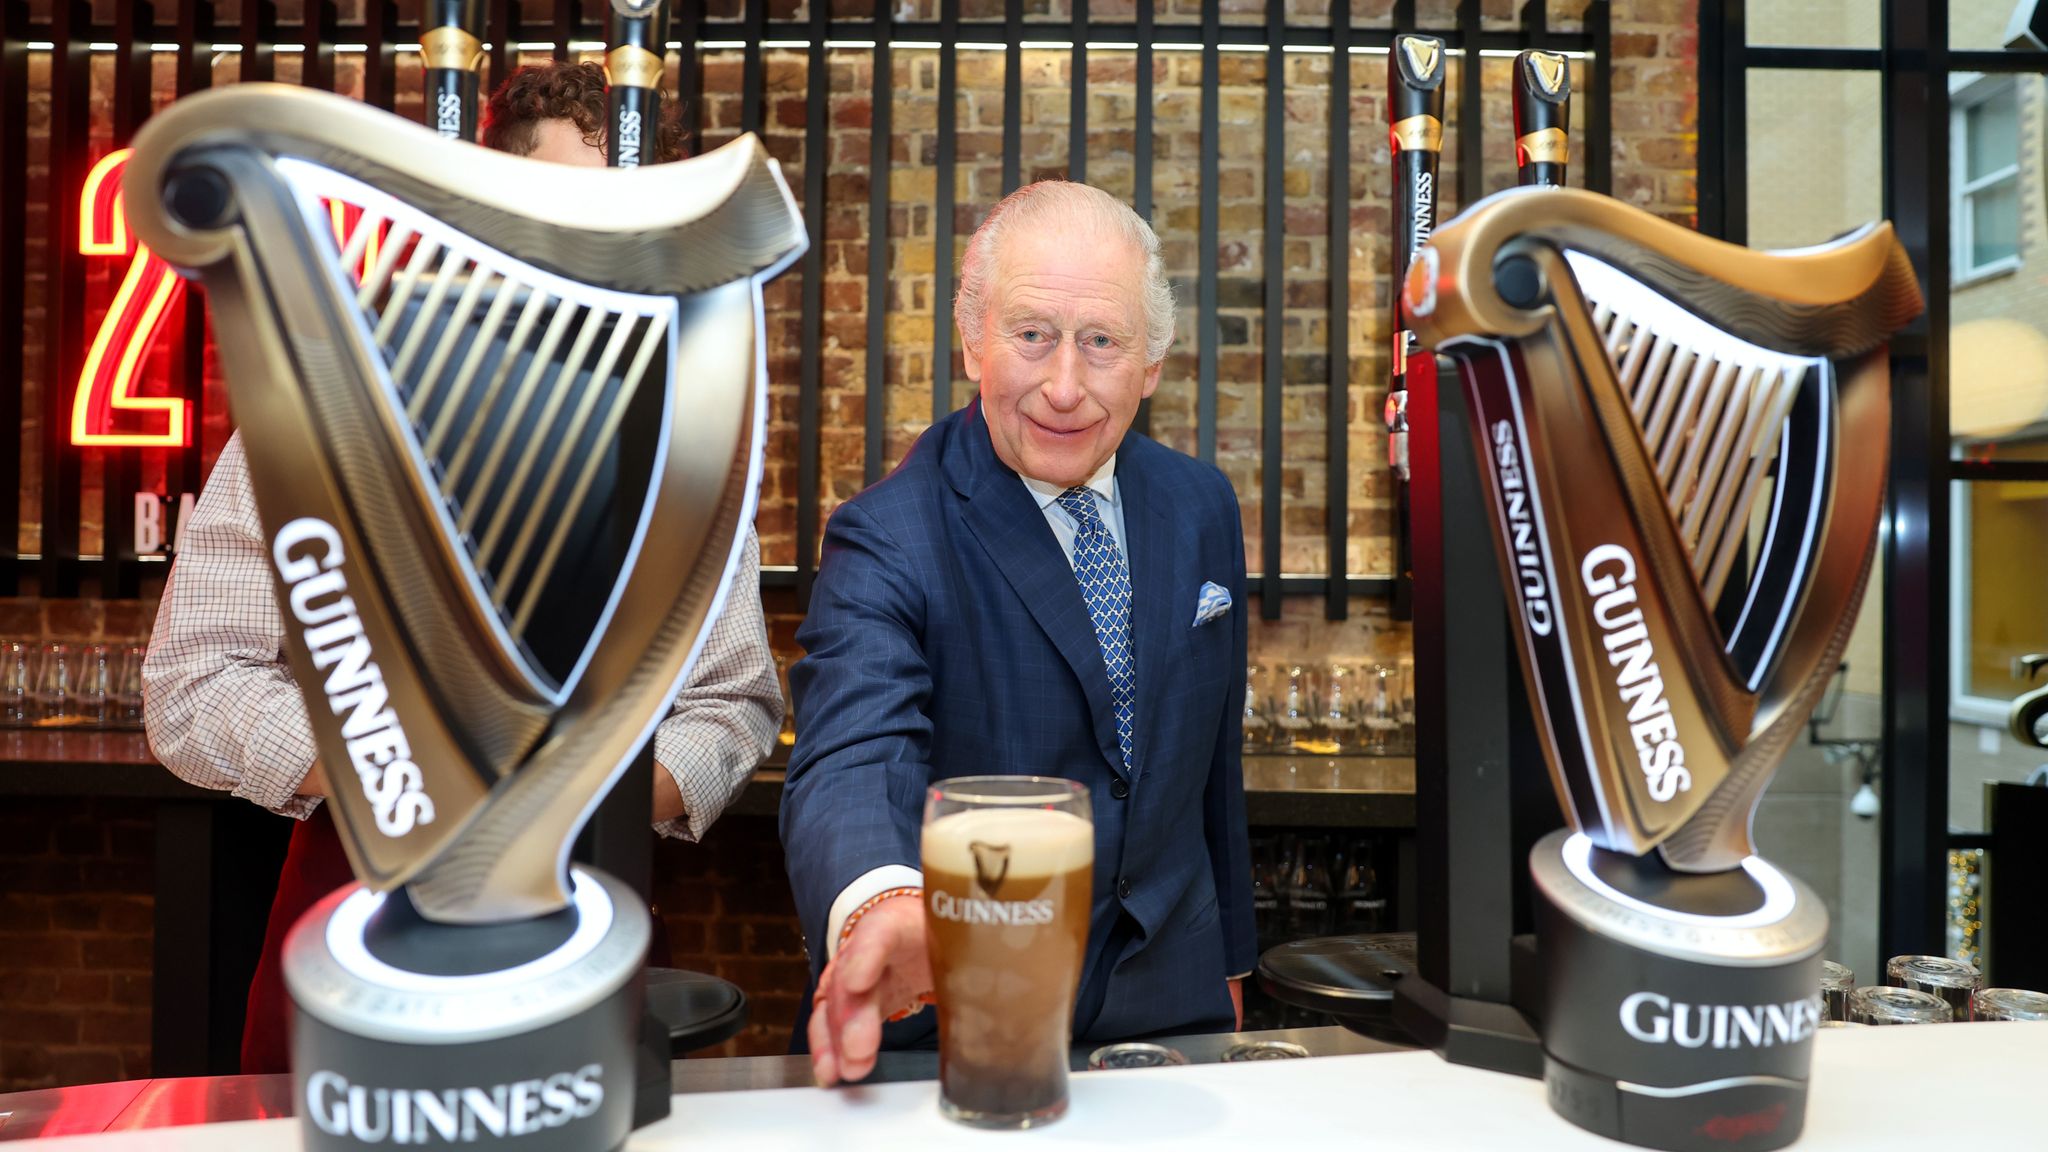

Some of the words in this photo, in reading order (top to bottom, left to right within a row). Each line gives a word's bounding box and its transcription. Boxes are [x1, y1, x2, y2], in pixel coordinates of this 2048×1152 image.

[1410, 172, 1433, 263] UINNESS
[1492, 419, 1552, 637] GUINNESS
[273, 517, 436, 837] GUINNESS
[1581, 543, 1691, 802] GUINNESS
[931, 890, 1055, 925] GUINNESS
[1620, 991, 1822, 1049] GUINNES
[306, 1063, 604, 1143] GUINNESS
